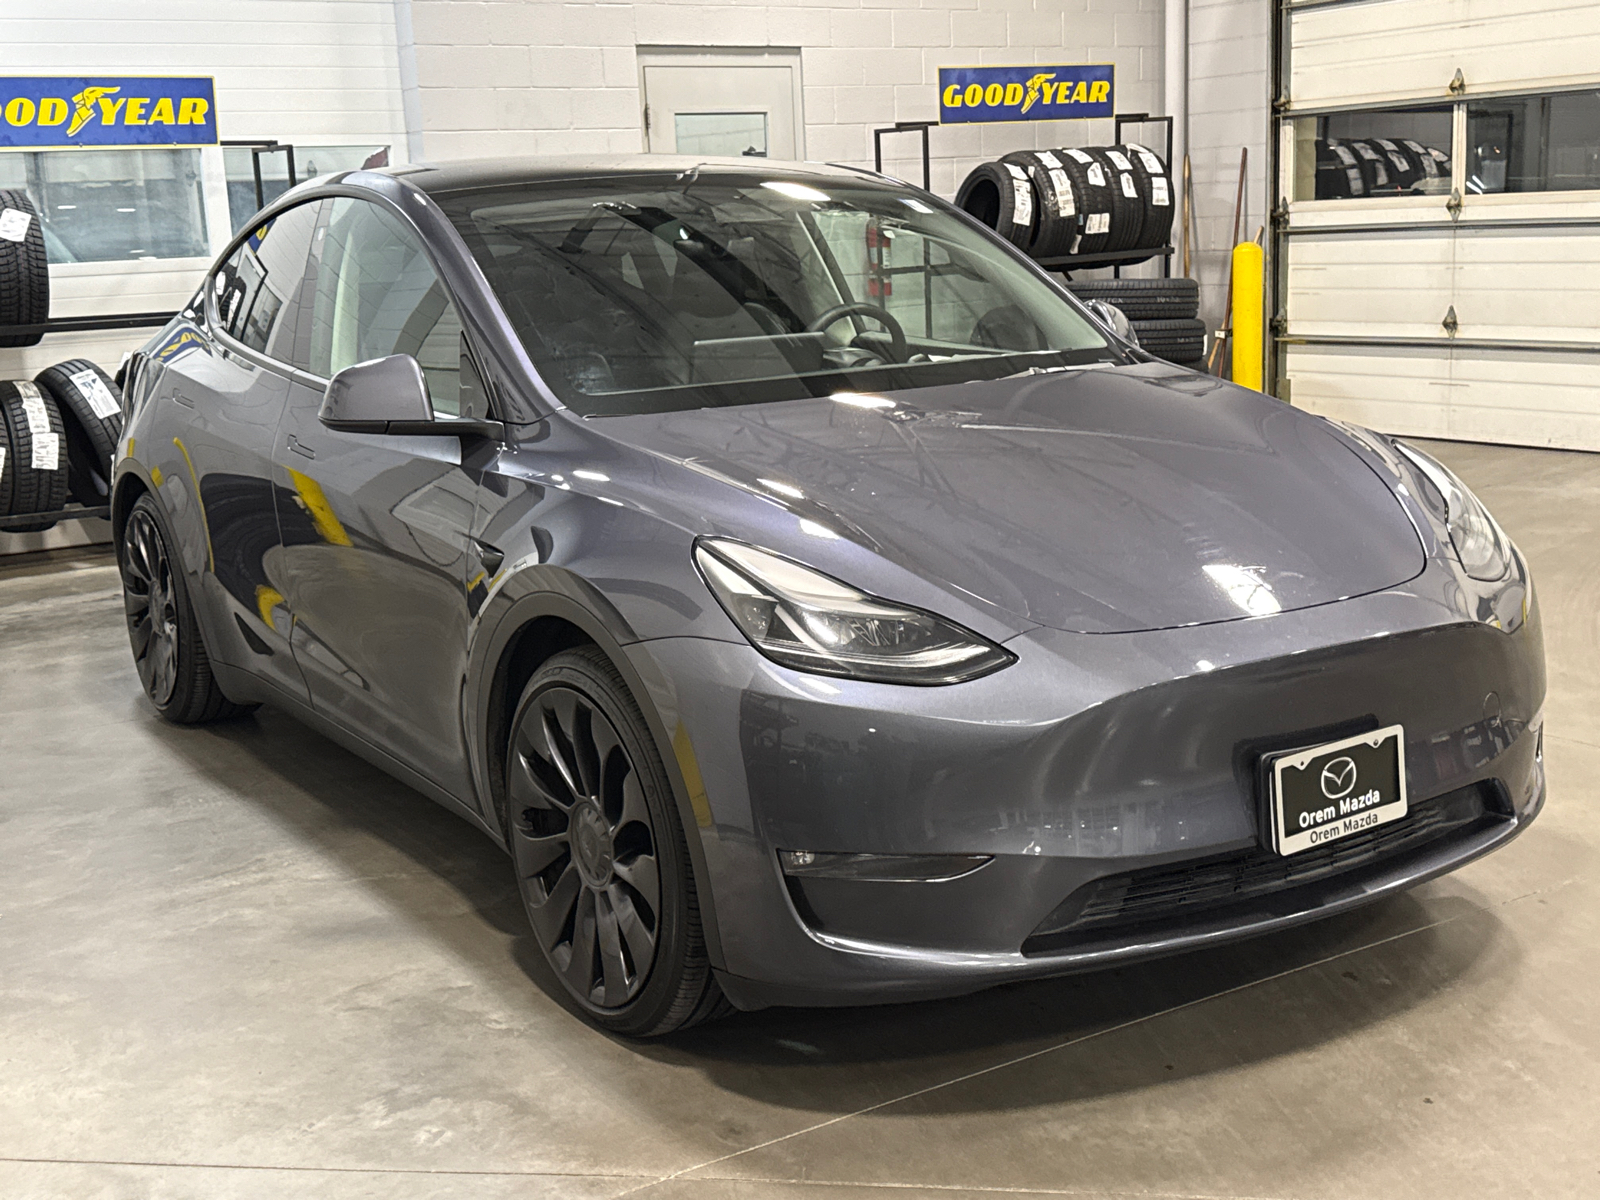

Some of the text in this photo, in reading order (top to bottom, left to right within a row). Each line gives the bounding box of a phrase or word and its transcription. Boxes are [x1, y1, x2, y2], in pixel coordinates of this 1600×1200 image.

[1299, 789, 1380, 828] Orem Mazda
[1310, 812, 1378, 844] Orem Mazda
